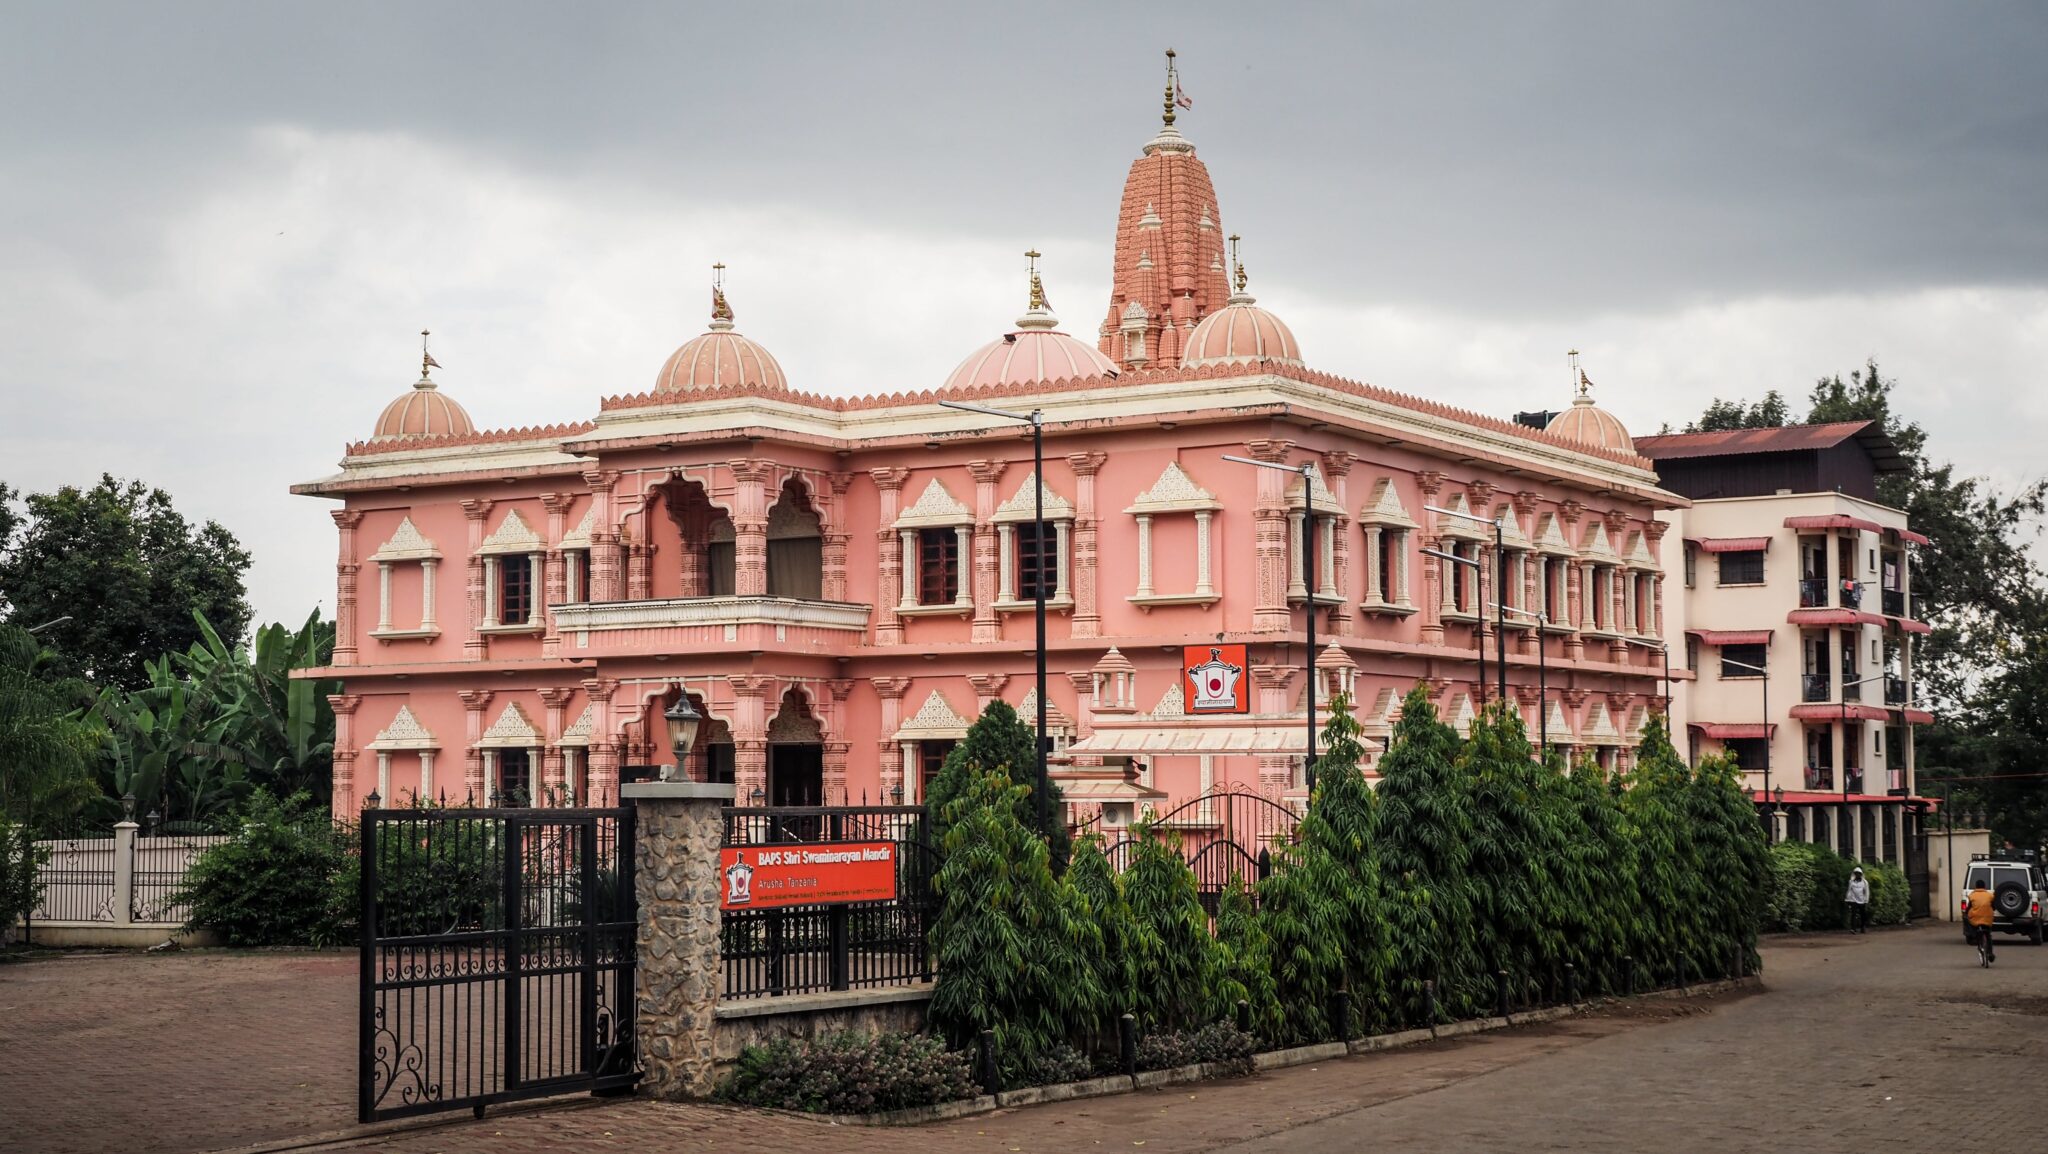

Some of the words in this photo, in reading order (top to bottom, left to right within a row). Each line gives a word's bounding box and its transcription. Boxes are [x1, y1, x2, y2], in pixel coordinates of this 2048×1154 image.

[759, 852, 781, 866] BAPS
[784, 851, 800, 865] Shri
[802, 849, 861, 864] Swaminarayan
[863, 847, 890, 861] Mandir
[787, 877, 817, 888] Tanzania
